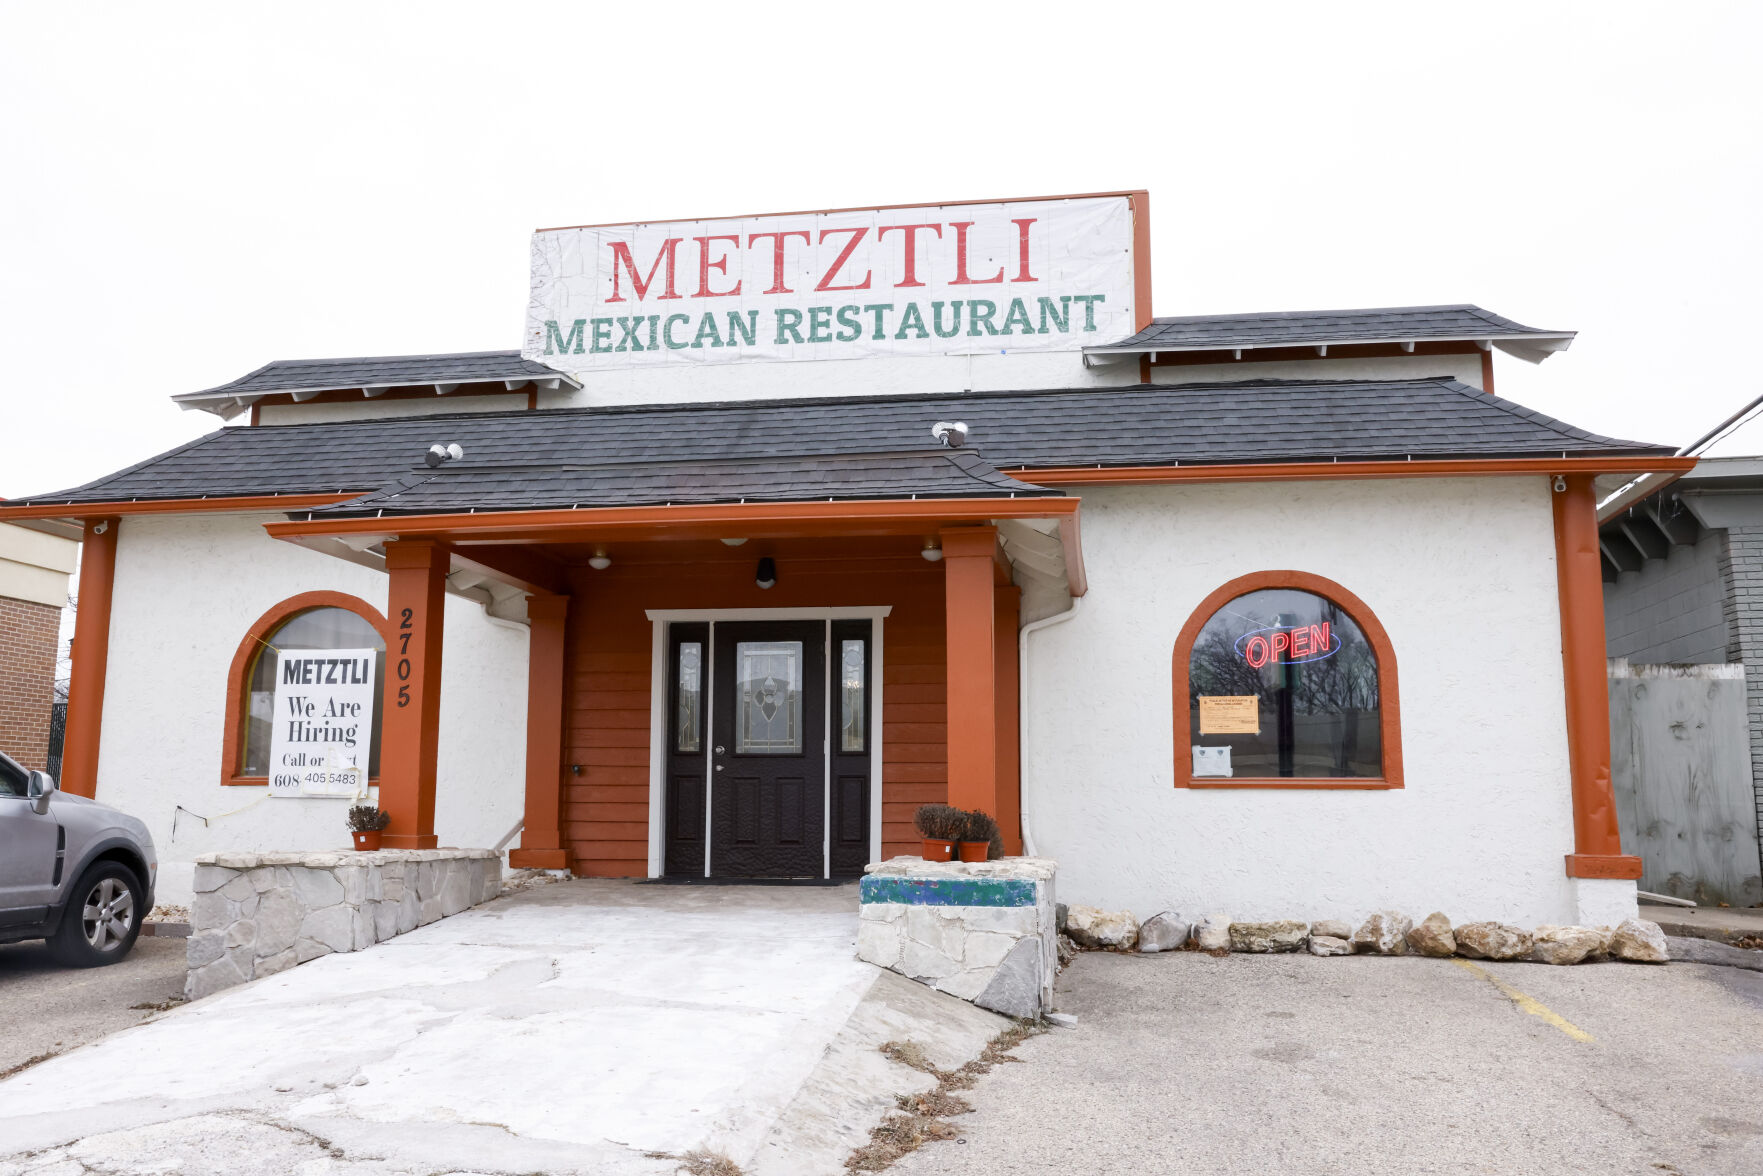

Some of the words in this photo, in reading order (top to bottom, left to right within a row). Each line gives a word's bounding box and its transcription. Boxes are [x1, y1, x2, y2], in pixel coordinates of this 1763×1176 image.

[605, 218, 1039, 303] METZTLI
[543, 309, 760, 356] MEXICAN
[773, 294, 1106, 345] RESTAURANT
[397, 607, 413, 708] 2705
[1245, 621, 1330, 669] OPEN
[283, 658, 369, 685] METZTLI
[287, 696, 316, 718] We
[322, 695, 361, 718] Are
[287, 720, 359, 748] Hiring
[282, 752, 306, 767] Call
[310, 756, 325, 767] or
[304, 772, 326, 784] 405
[328, 773, 357, 785] 5483
